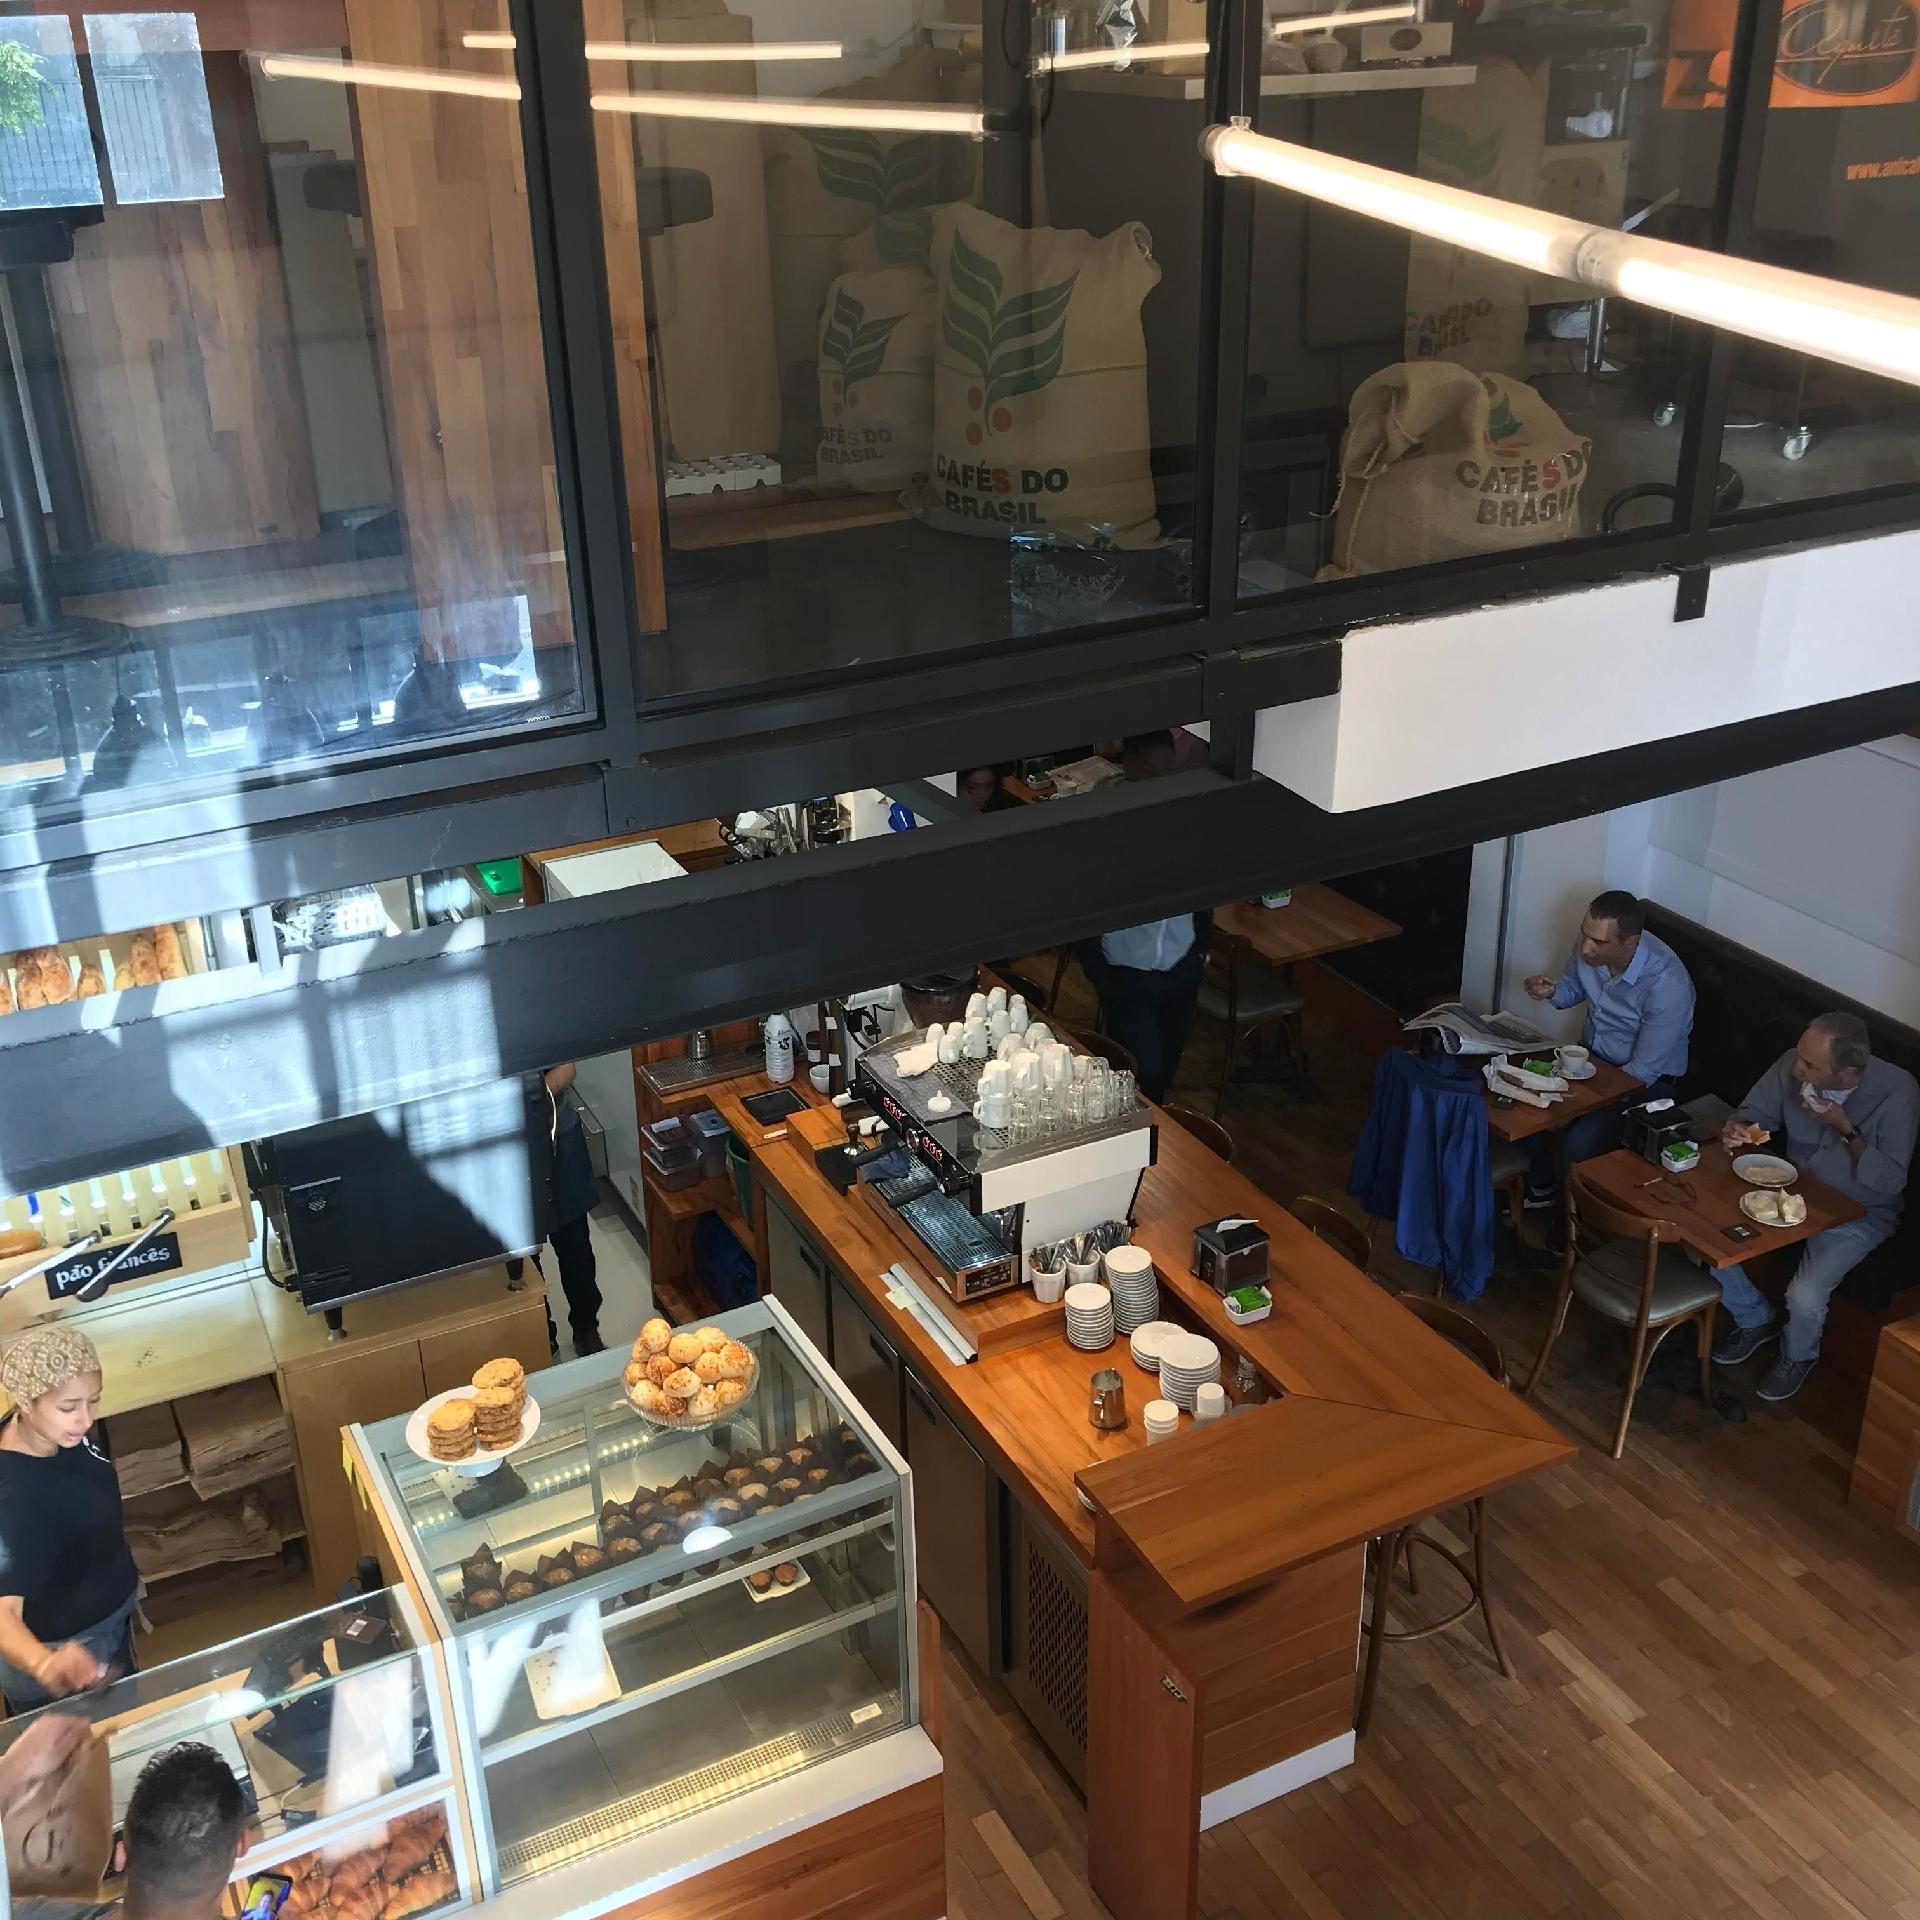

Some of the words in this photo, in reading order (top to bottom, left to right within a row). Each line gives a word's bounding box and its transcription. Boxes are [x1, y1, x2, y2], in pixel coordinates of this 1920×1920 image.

[936, 453, 1012, 495] CAFÉS
[1021, 467, 1069, 494] DO
[1455, 458, 1562, 495] CAFÉS
[945, 489, 1047, 525] BRASIL
[55, 1263, 94, 1291] pão
[97, 1247, 171, 1271] fncês
